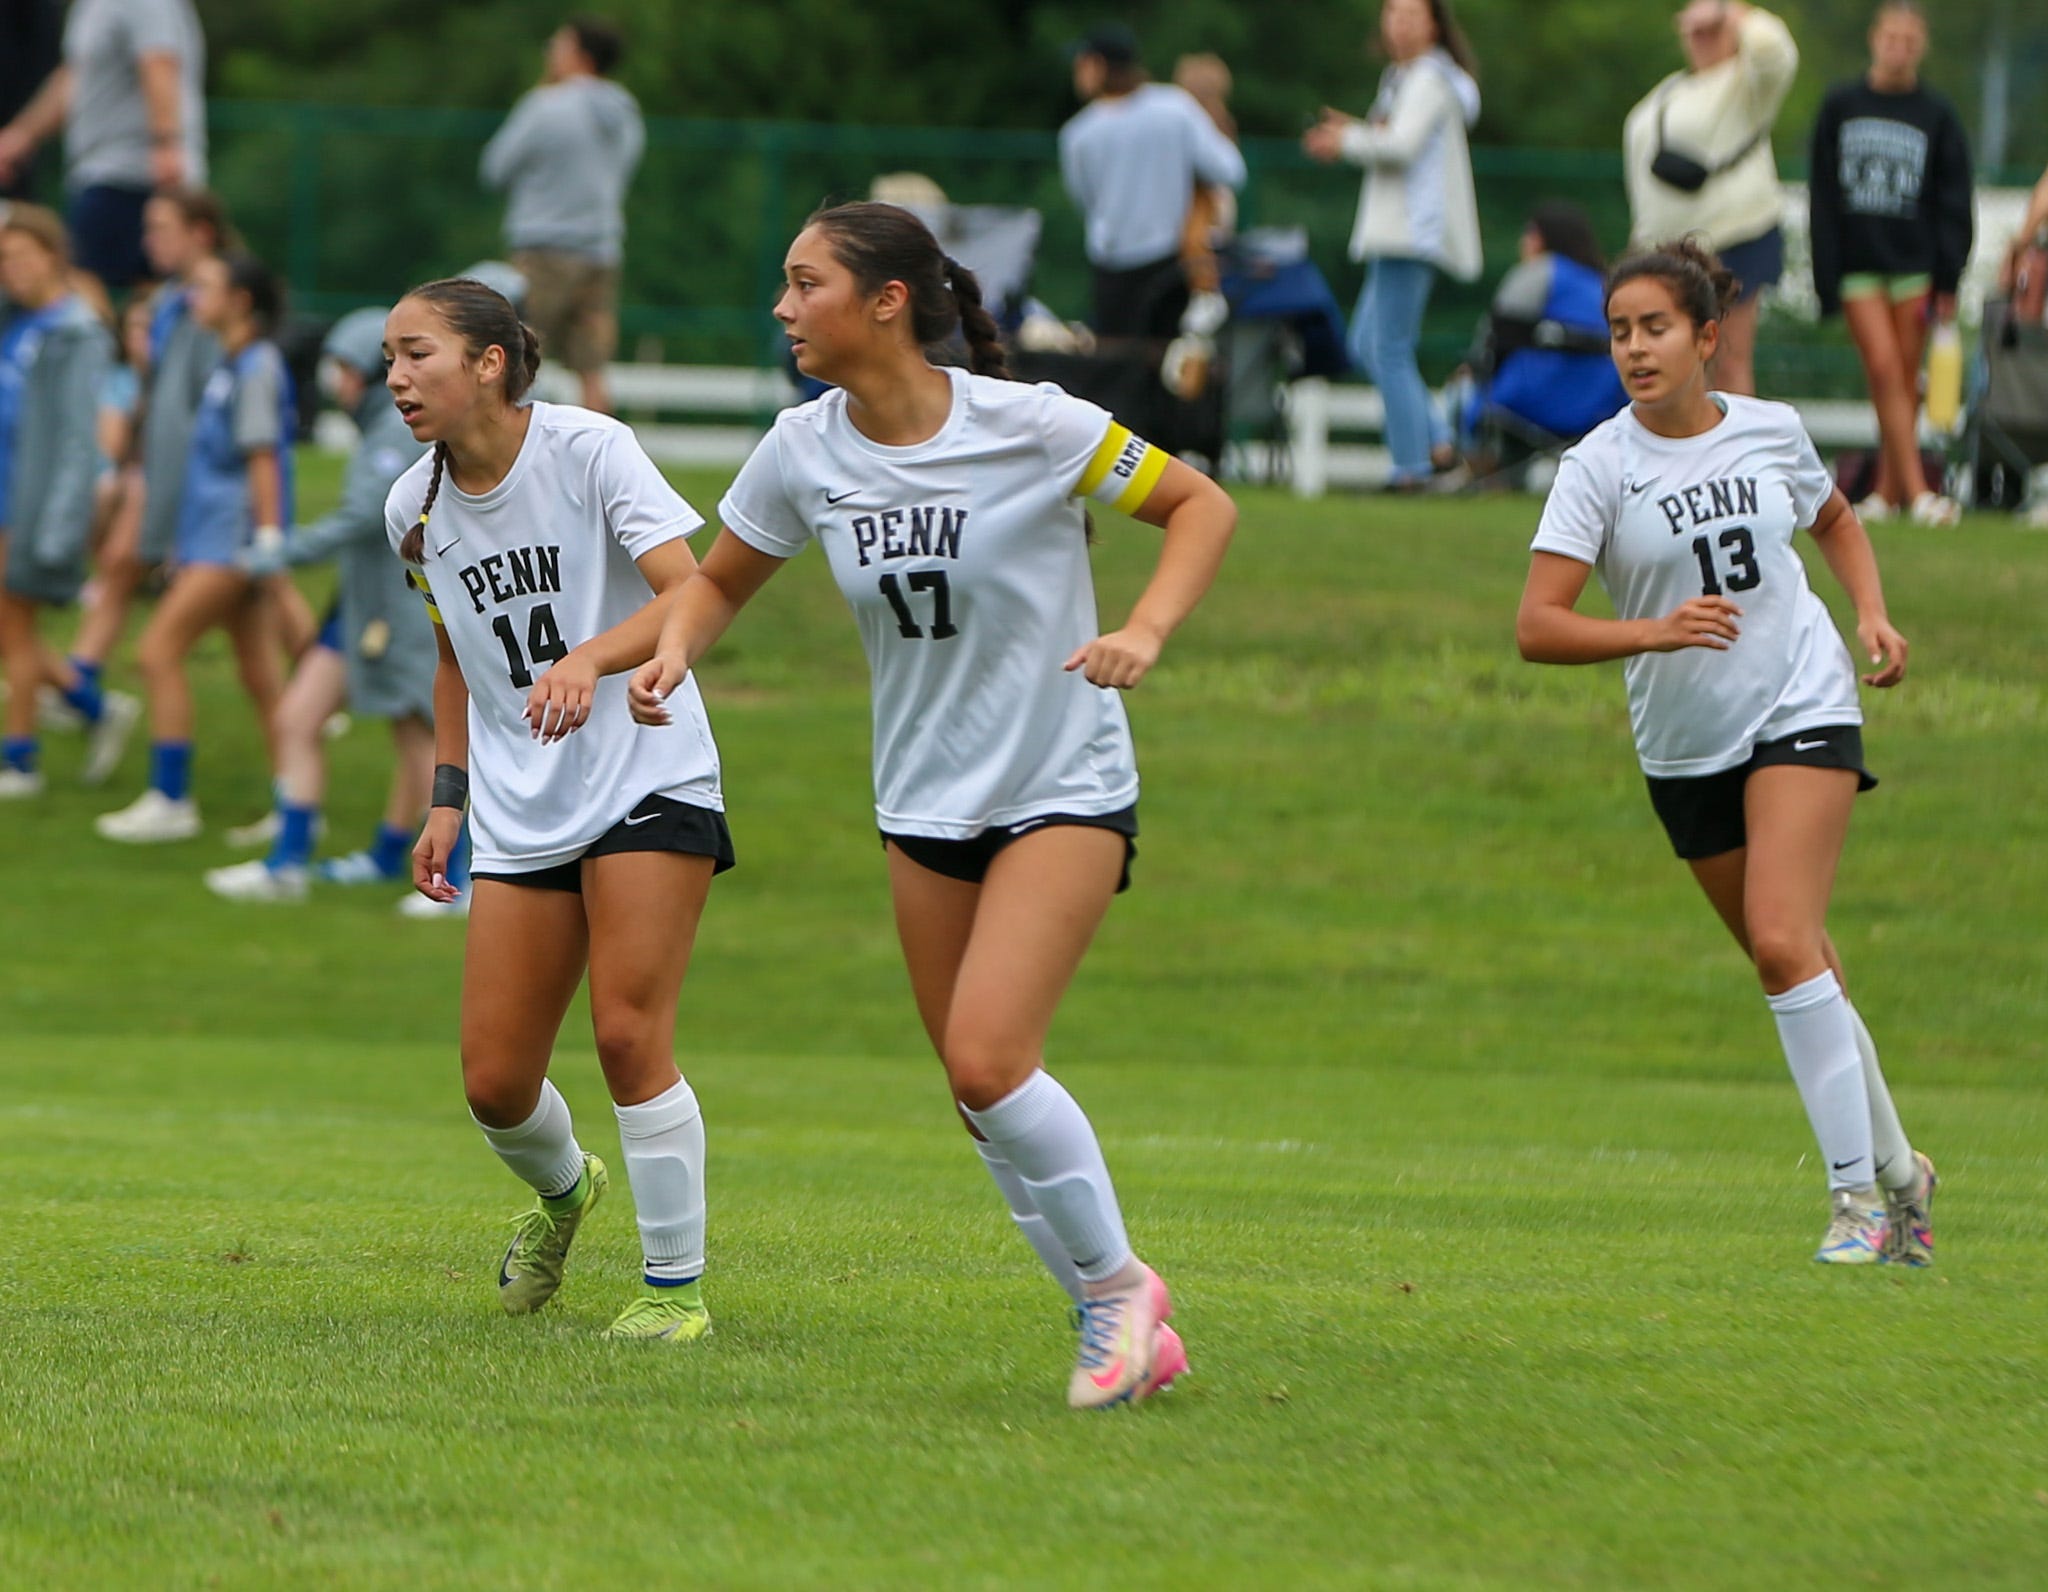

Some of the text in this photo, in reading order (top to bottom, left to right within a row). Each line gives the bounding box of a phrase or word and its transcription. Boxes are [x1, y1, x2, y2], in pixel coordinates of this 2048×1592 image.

[1113, 436, 1147, 478] CAPTA
[852, 506, 968, 567] PENN
[1658, 476, 1758, 535] PENN
[459, 546, 561, 614] PENN
[1692, 524, 1761, 596] 13
[878, 570, 959, 640] 17
[492, 603, 569, 689] 14
